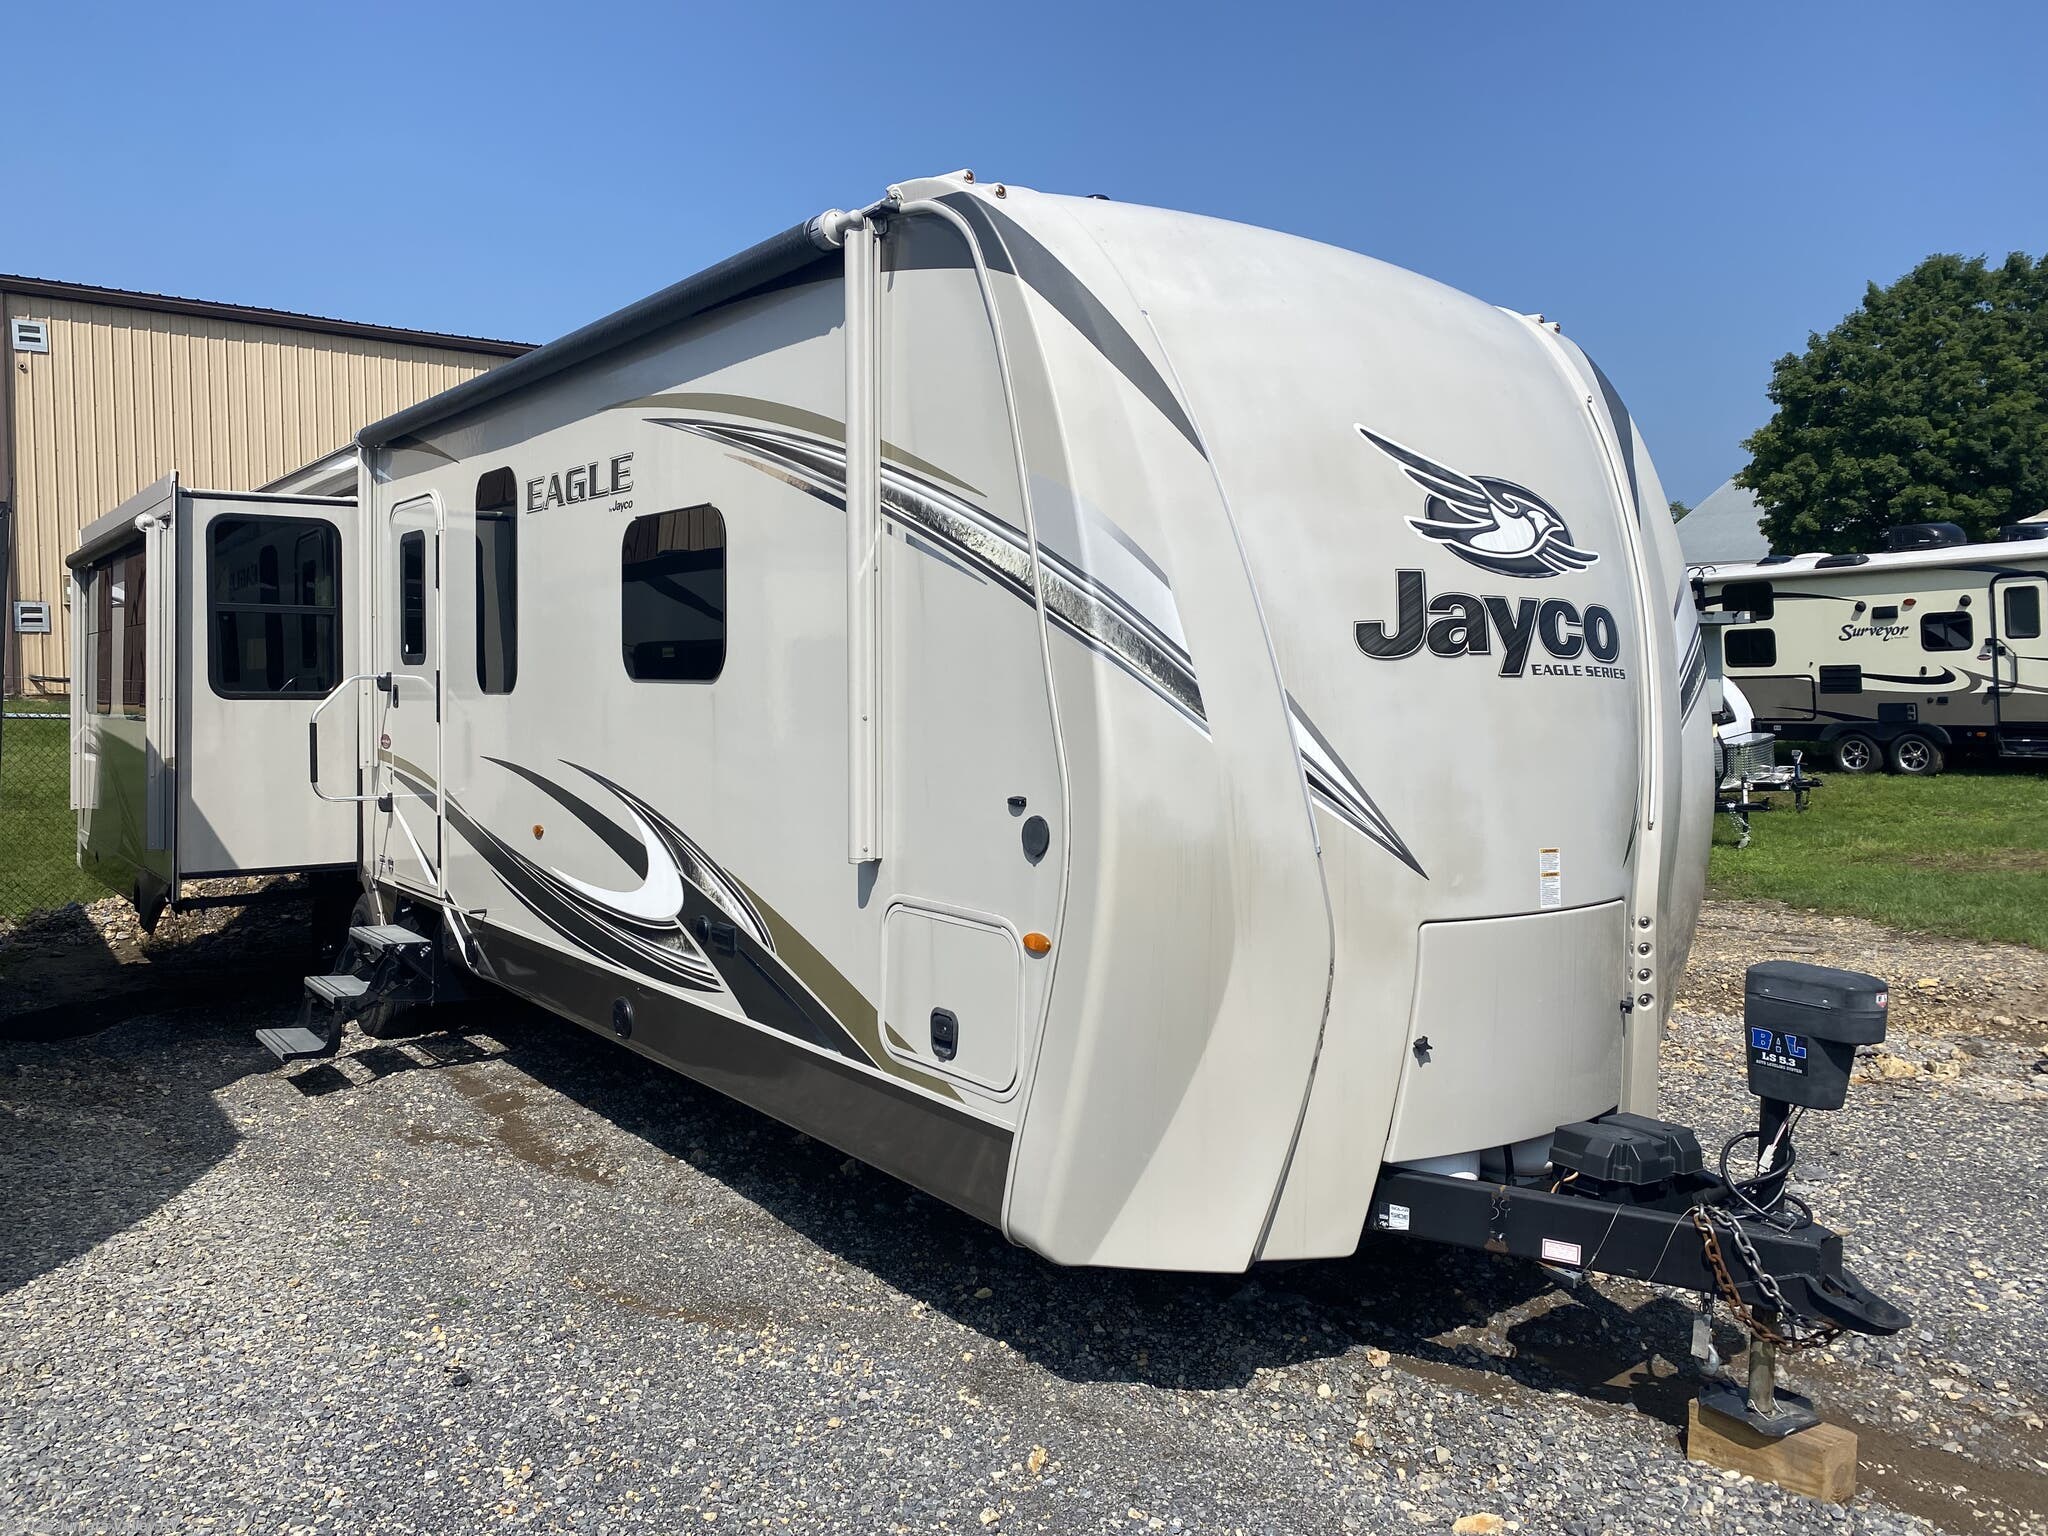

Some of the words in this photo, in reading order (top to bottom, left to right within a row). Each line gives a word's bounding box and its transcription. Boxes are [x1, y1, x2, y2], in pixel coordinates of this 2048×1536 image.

[526, 452, 634, 514] EAGLE
[612, 500, 633, 512] Jayco
[1353, 568, 1621, 678] Jayco
[1838, 624, 1909, 641] Surveyor
[1531, 664, 1583, 677] EAGLE
[1586, 666, 1626, 680] SERIES
[1761, 1052, 1777, 1062] LS
[1778, 1056, 1796, 1067] 5.3
